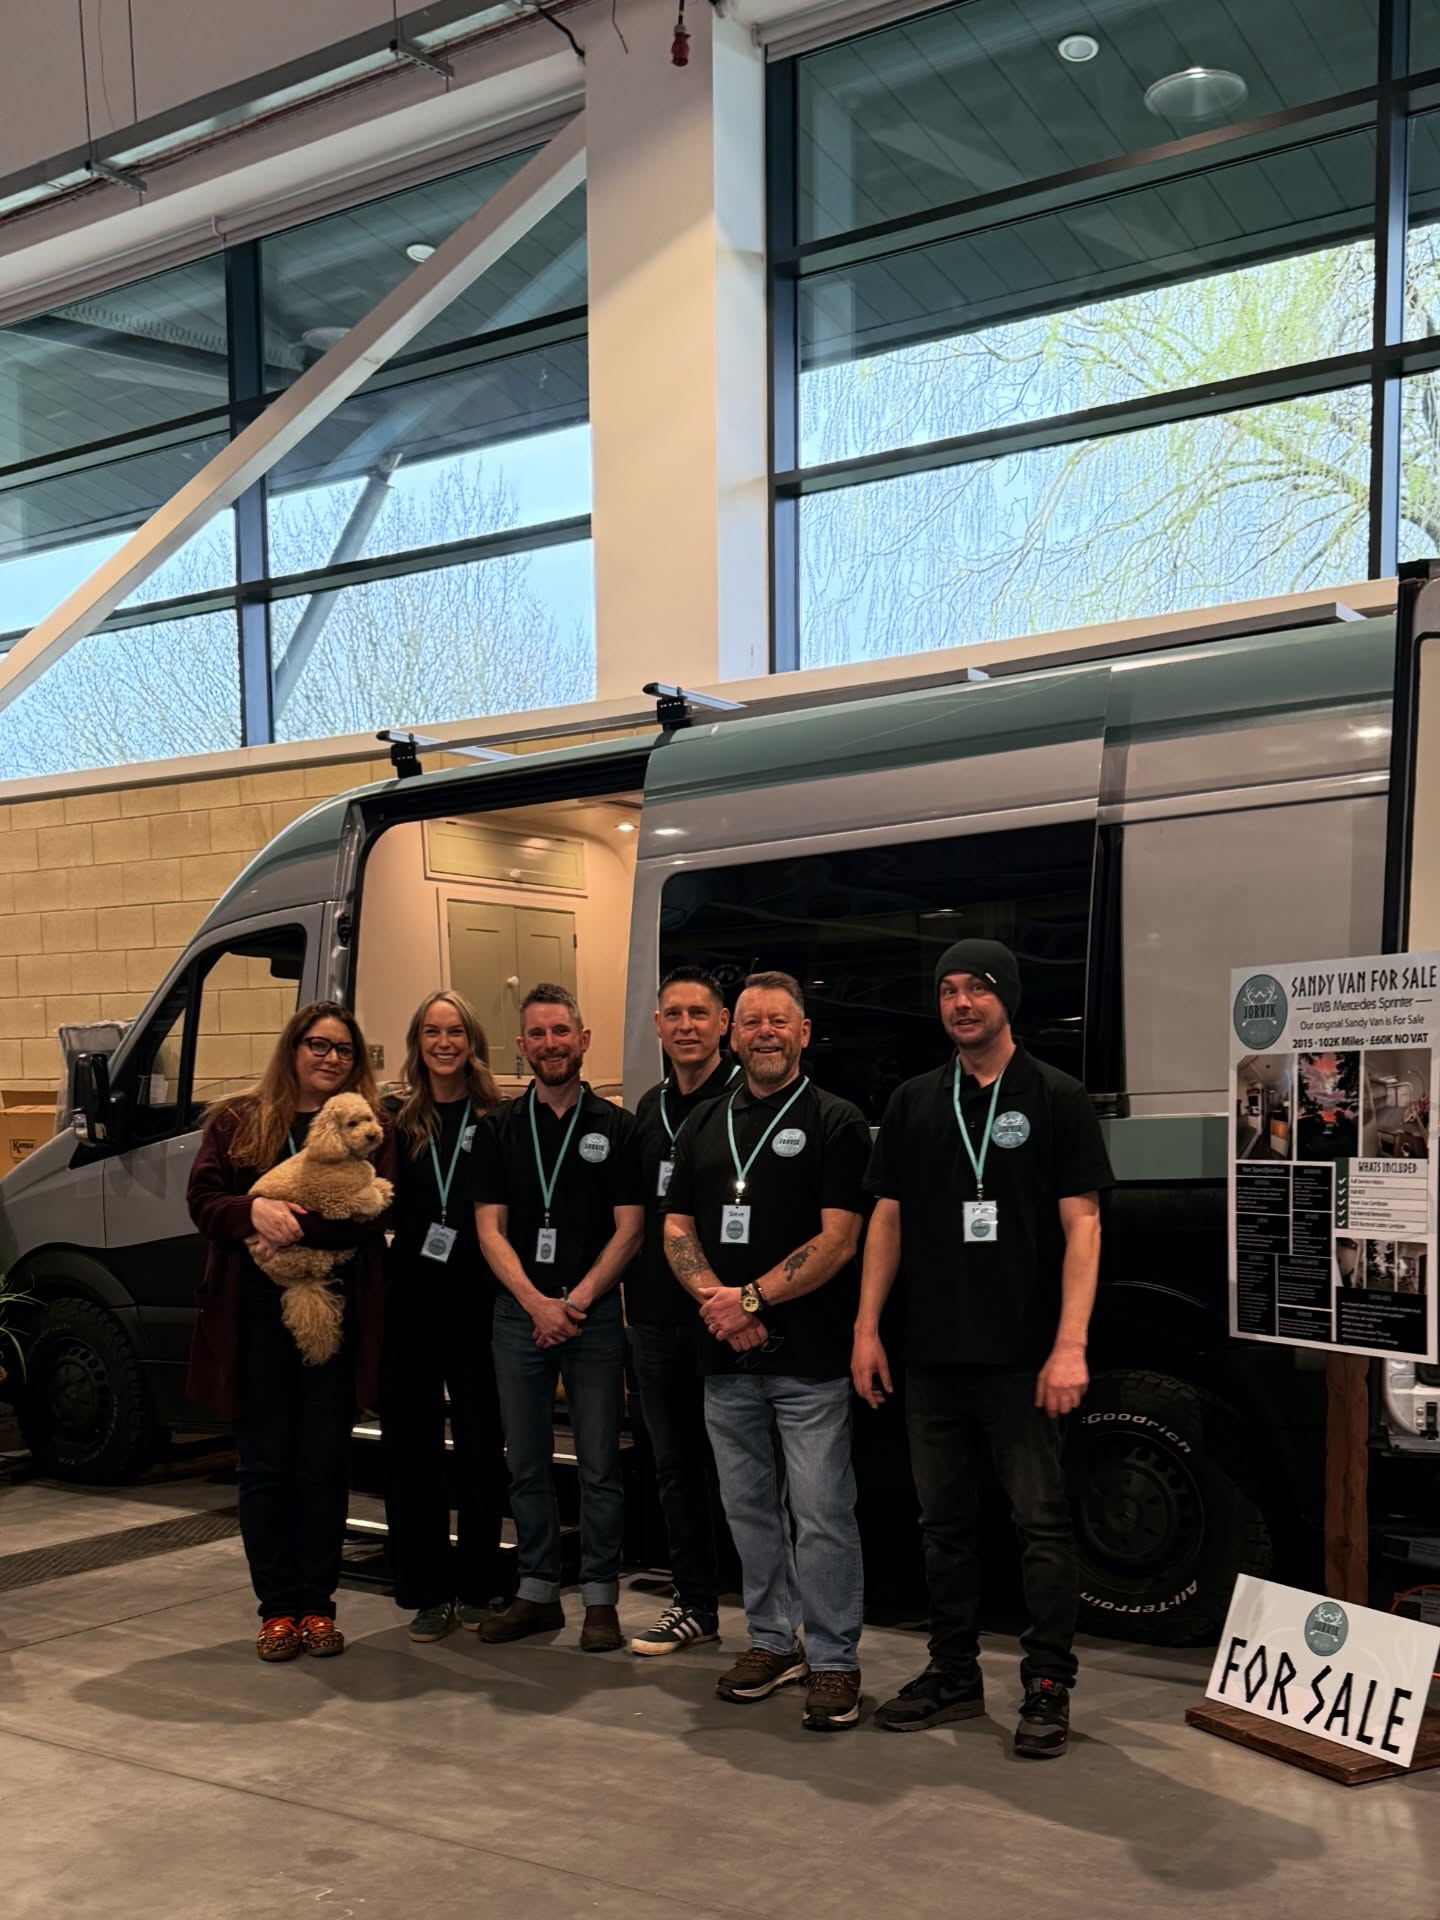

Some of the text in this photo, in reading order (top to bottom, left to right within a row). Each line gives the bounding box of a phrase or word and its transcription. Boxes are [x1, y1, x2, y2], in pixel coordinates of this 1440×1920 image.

[1291, 965, 1437, 998] SANDY VAN FOR SALE
[1243, 1004, 1277, 1019] JORVIK
[1332, 998, 1377, 1012] Mercedes
[1378, 997, 1414, 1012] Sprinter
[1300, 1014, 1425, 1032] Our original Sandy Van is For Sale
[1292, 1038, 1314, 1048] 2015
[1319, 1037, 1340, 1047] 102K
[1342, 1036, 1365, 1046] Miles
[1394, 1033, 1410, 1044] NO
[1410, 1032, 1429, 1043] VAT
[1358, 1161, 1418, 1174] WHATS INCLUDED
[1218, 1636, 1413, 1755] FOR SALE
